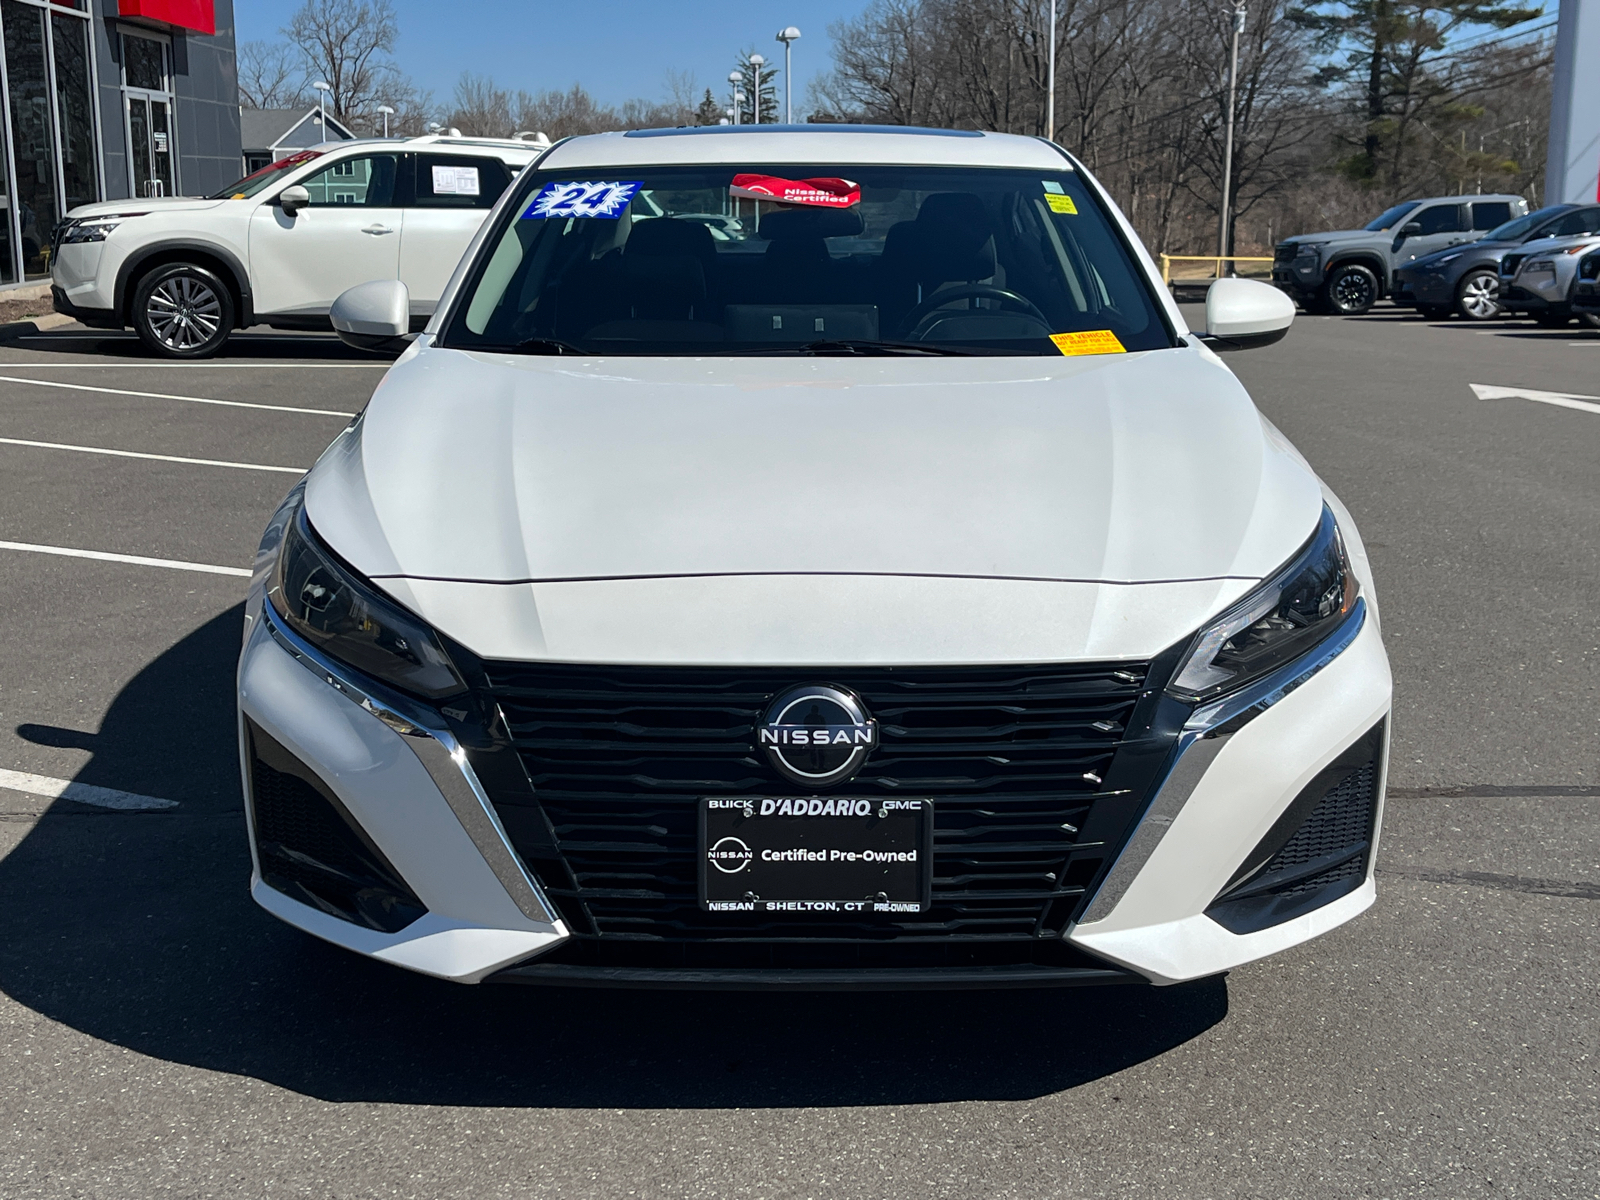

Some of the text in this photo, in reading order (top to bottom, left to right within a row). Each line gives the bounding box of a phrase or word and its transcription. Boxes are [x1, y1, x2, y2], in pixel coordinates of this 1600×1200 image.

[550, 187, 615, 210] 24
[783, 195, 849, 203] Certified
[1075, 331, 1112, 339] VEHICLE
[761, 728, 872, 744] NISSAN
[708, 799, 922, 816] BUICK D'ADDARIO GMC
[708, 851, 753, 859] NISSAN
[761, 849, 917, 862] Certified Pre-Owned
[708, 902, 920, 912] NISSAN SHELTON, CT PRE-OWNED
